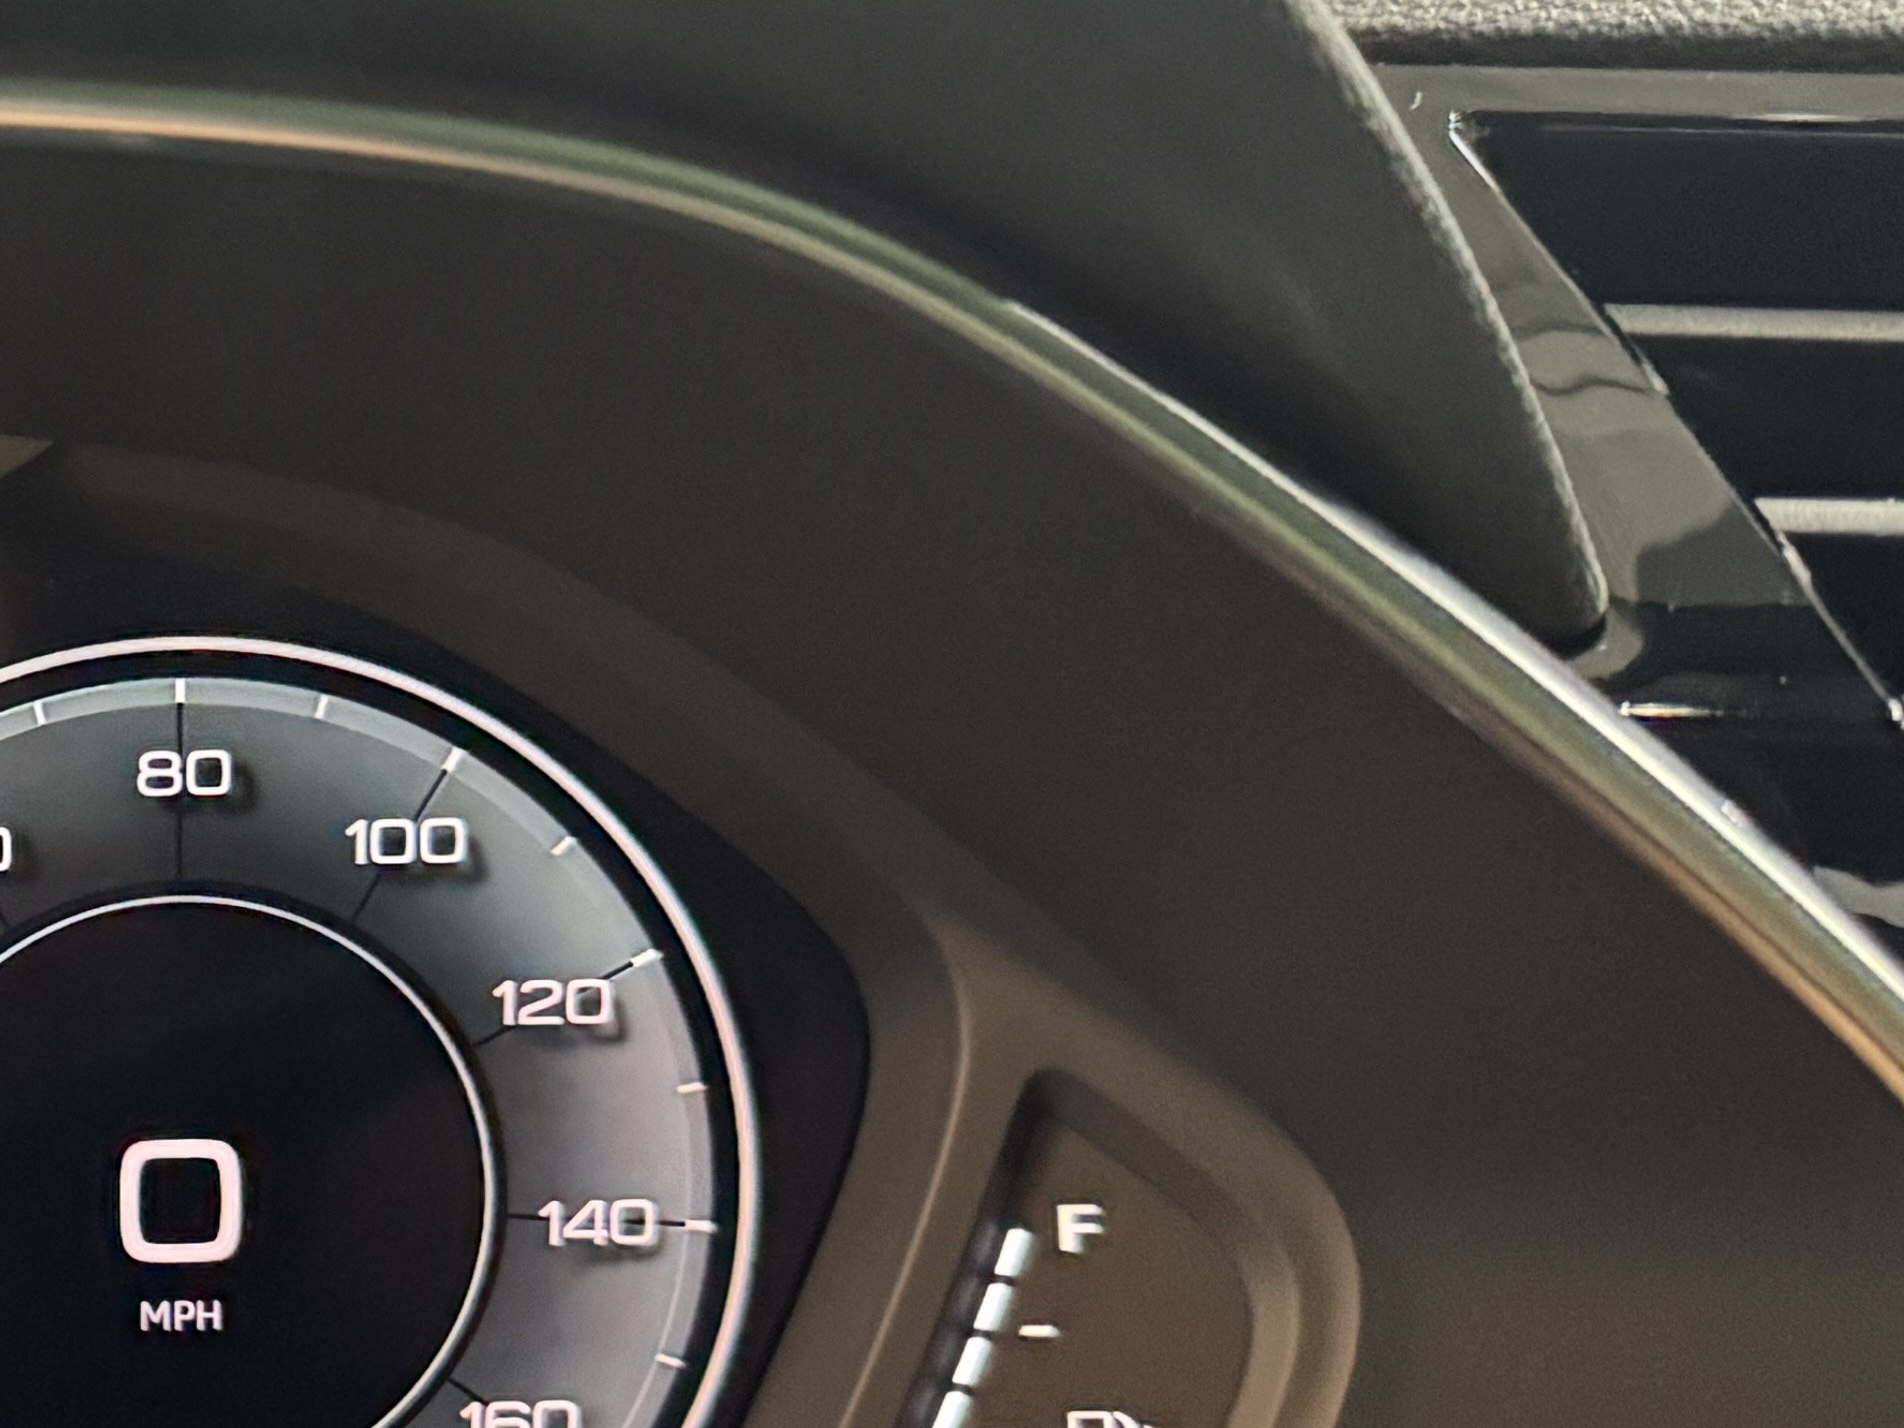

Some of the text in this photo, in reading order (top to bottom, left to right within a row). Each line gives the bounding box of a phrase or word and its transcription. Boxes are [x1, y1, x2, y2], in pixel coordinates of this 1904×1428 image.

[136, 748, 232, 798] 80
[344, 816, 467, 866] 100
[492, 977, 613, 1026] 120
[118, 1137, 243, 1265] 0
[538, 1197, 656, 1247] 140
[1055, 1202, 1104, 1254] F
[139, 1298, 223, 1332] MPH
